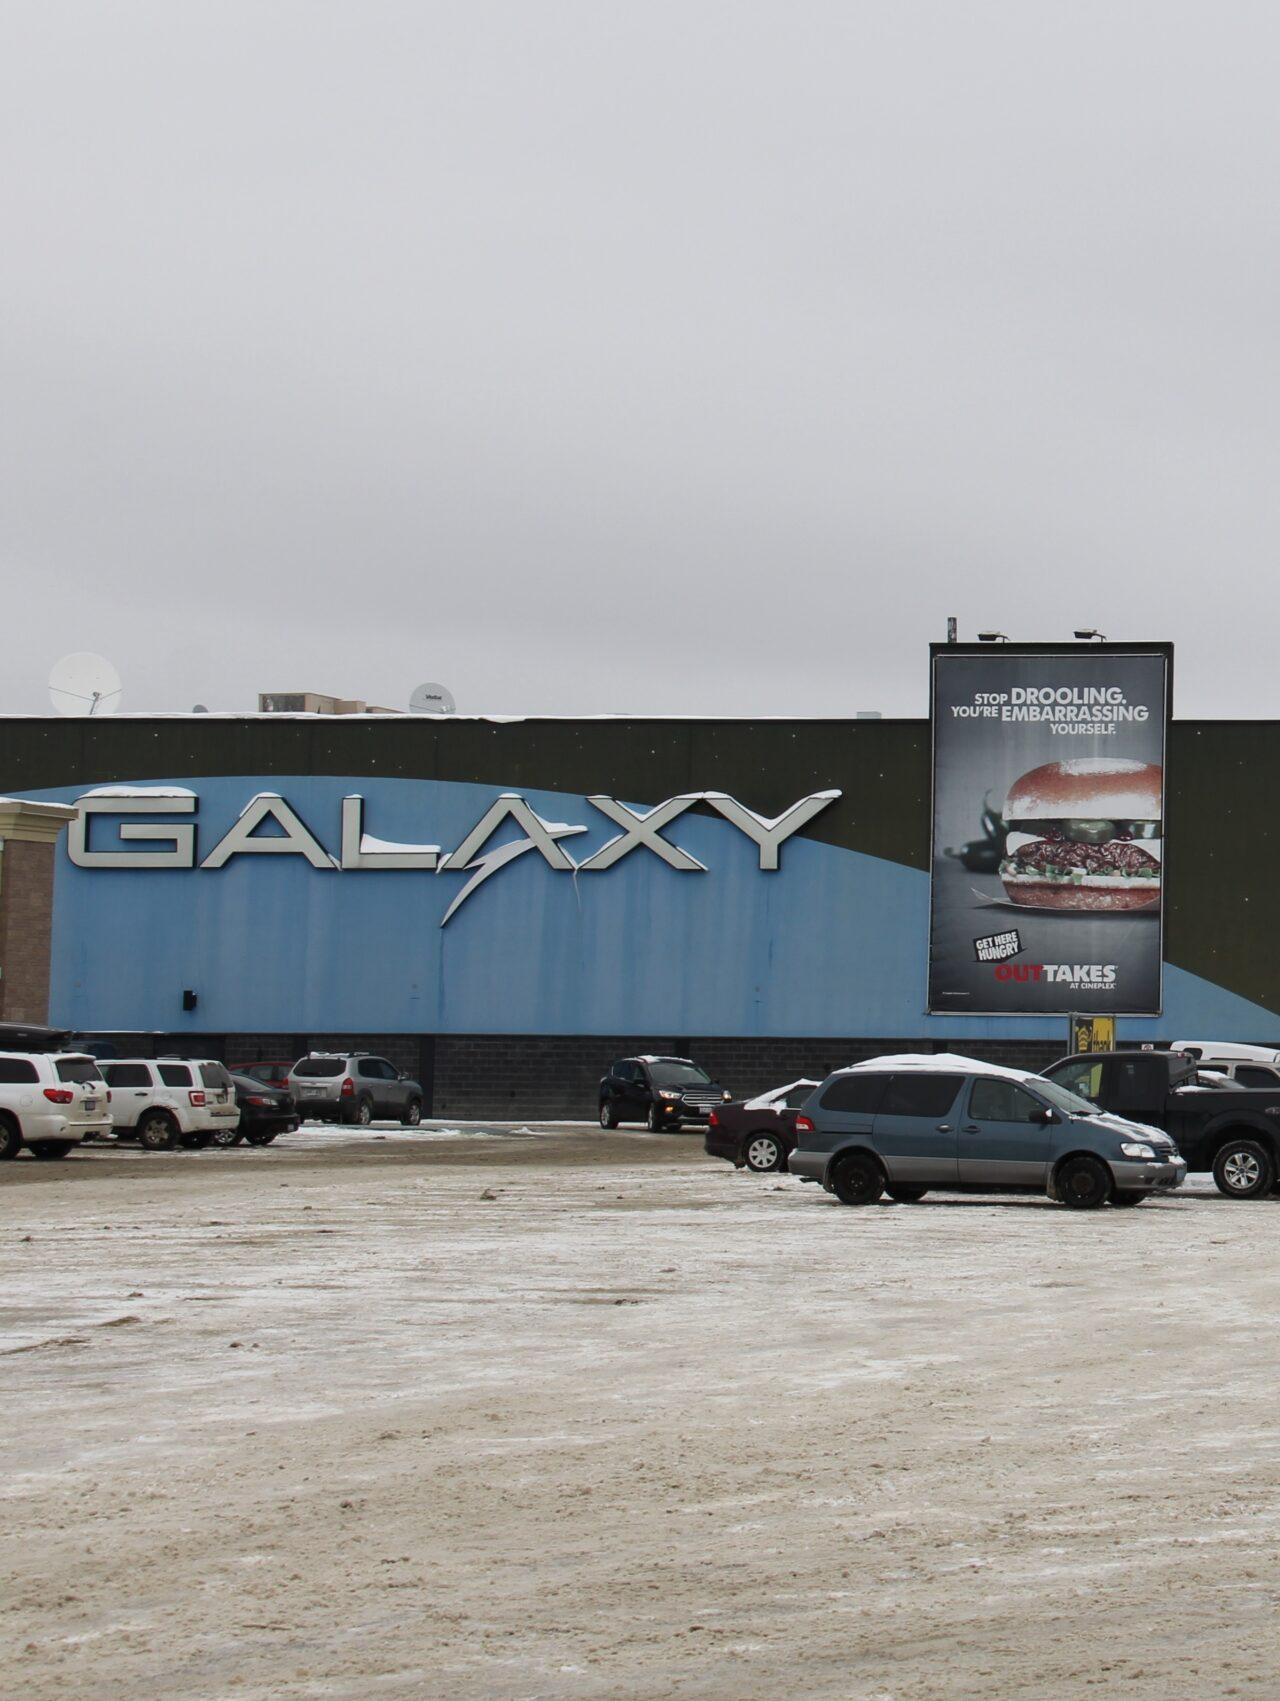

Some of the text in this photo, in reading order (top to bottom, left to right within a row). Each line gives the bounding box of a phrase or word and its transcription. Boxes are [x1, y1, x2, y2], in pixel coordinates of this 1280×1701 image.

[974, 687, 1127, 705] STOP DROOLING.
[951, 705, 1149, 722] YOU'RE EMBARRASSING
[1050, 723, 1116, 735] YOURSELF.
[67, 789, 843, 928] GALAXY
[976, 932, 1018, 950] GET HERE
[977, 942, 1019, 961] HUNGRY
